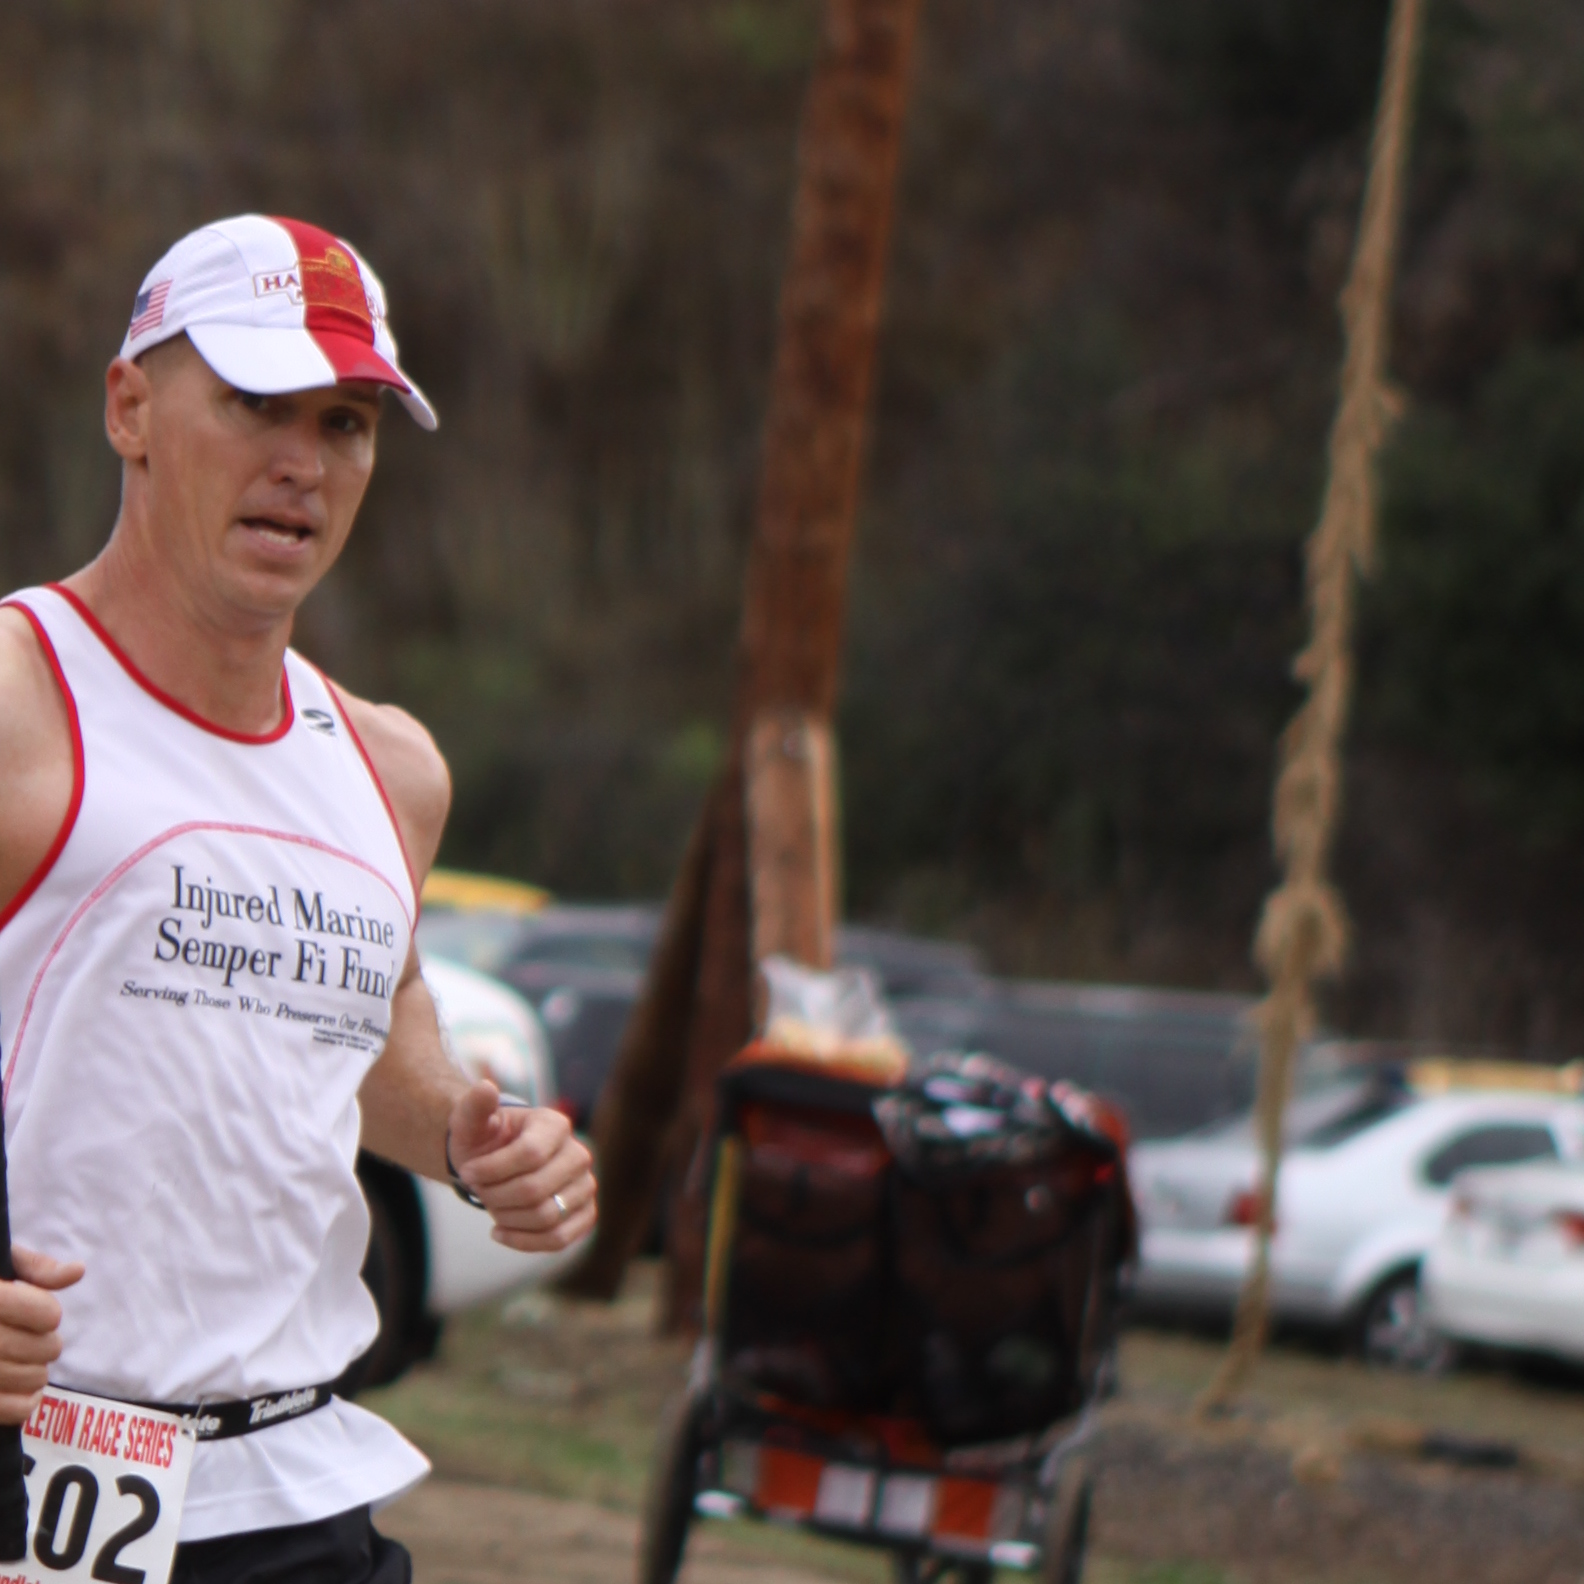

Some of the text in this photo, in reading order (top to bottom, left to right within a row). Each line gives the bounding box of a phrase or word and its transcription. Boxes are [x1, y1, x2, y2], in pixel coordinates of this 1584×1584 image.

[171, 866, 394, 949] Injured Marine
[154, 918, 281, 987] Semper
[291, 940, 326, 986] Fi
[120, 980, 190, 1007] Serving
[193, 988, 231, 1010] Those
[238, 995, 271, 1015] Who
[77, 1404, 125, 1457] RACE
[123, 1415, 177, 1469] SERIES
